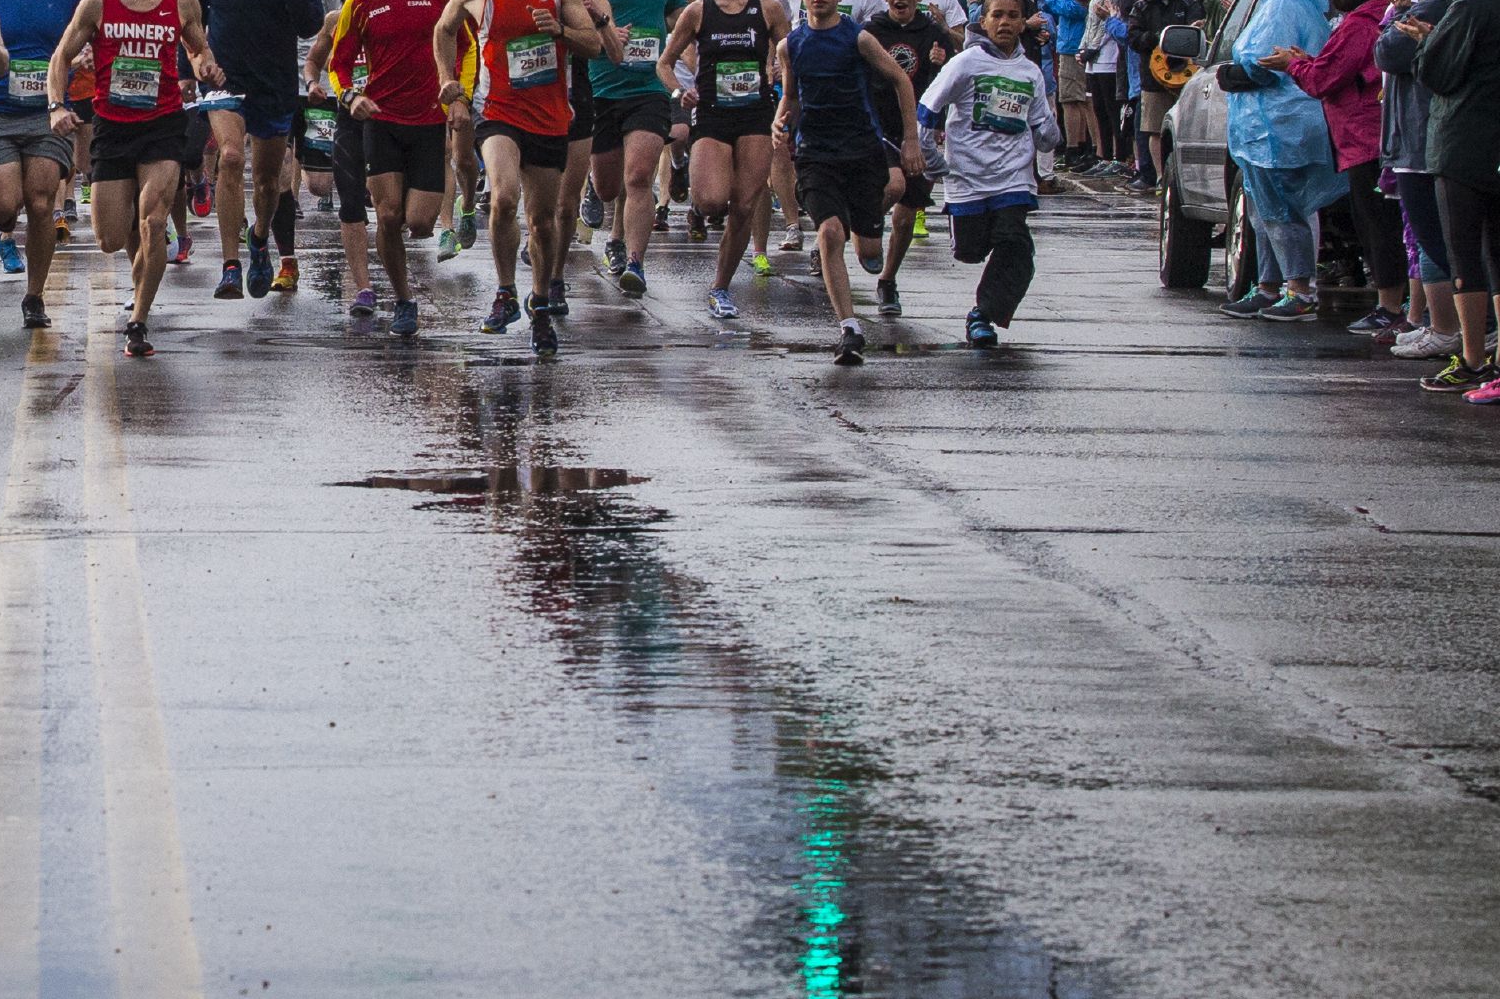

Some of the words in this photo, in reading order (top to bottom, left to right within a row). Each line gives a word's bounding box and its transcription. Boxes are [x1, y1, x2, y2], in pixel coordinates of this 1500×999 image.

[103, 23, 176, 42] RUNNER'S
[118, 41, 163, 59] ALLEY
[520, 57, 547, 70] 2518
[20, 80, 44, 91] 1831
[121, 81, 149, 90] 2607
[998, 99, 1022, 114] 2150
